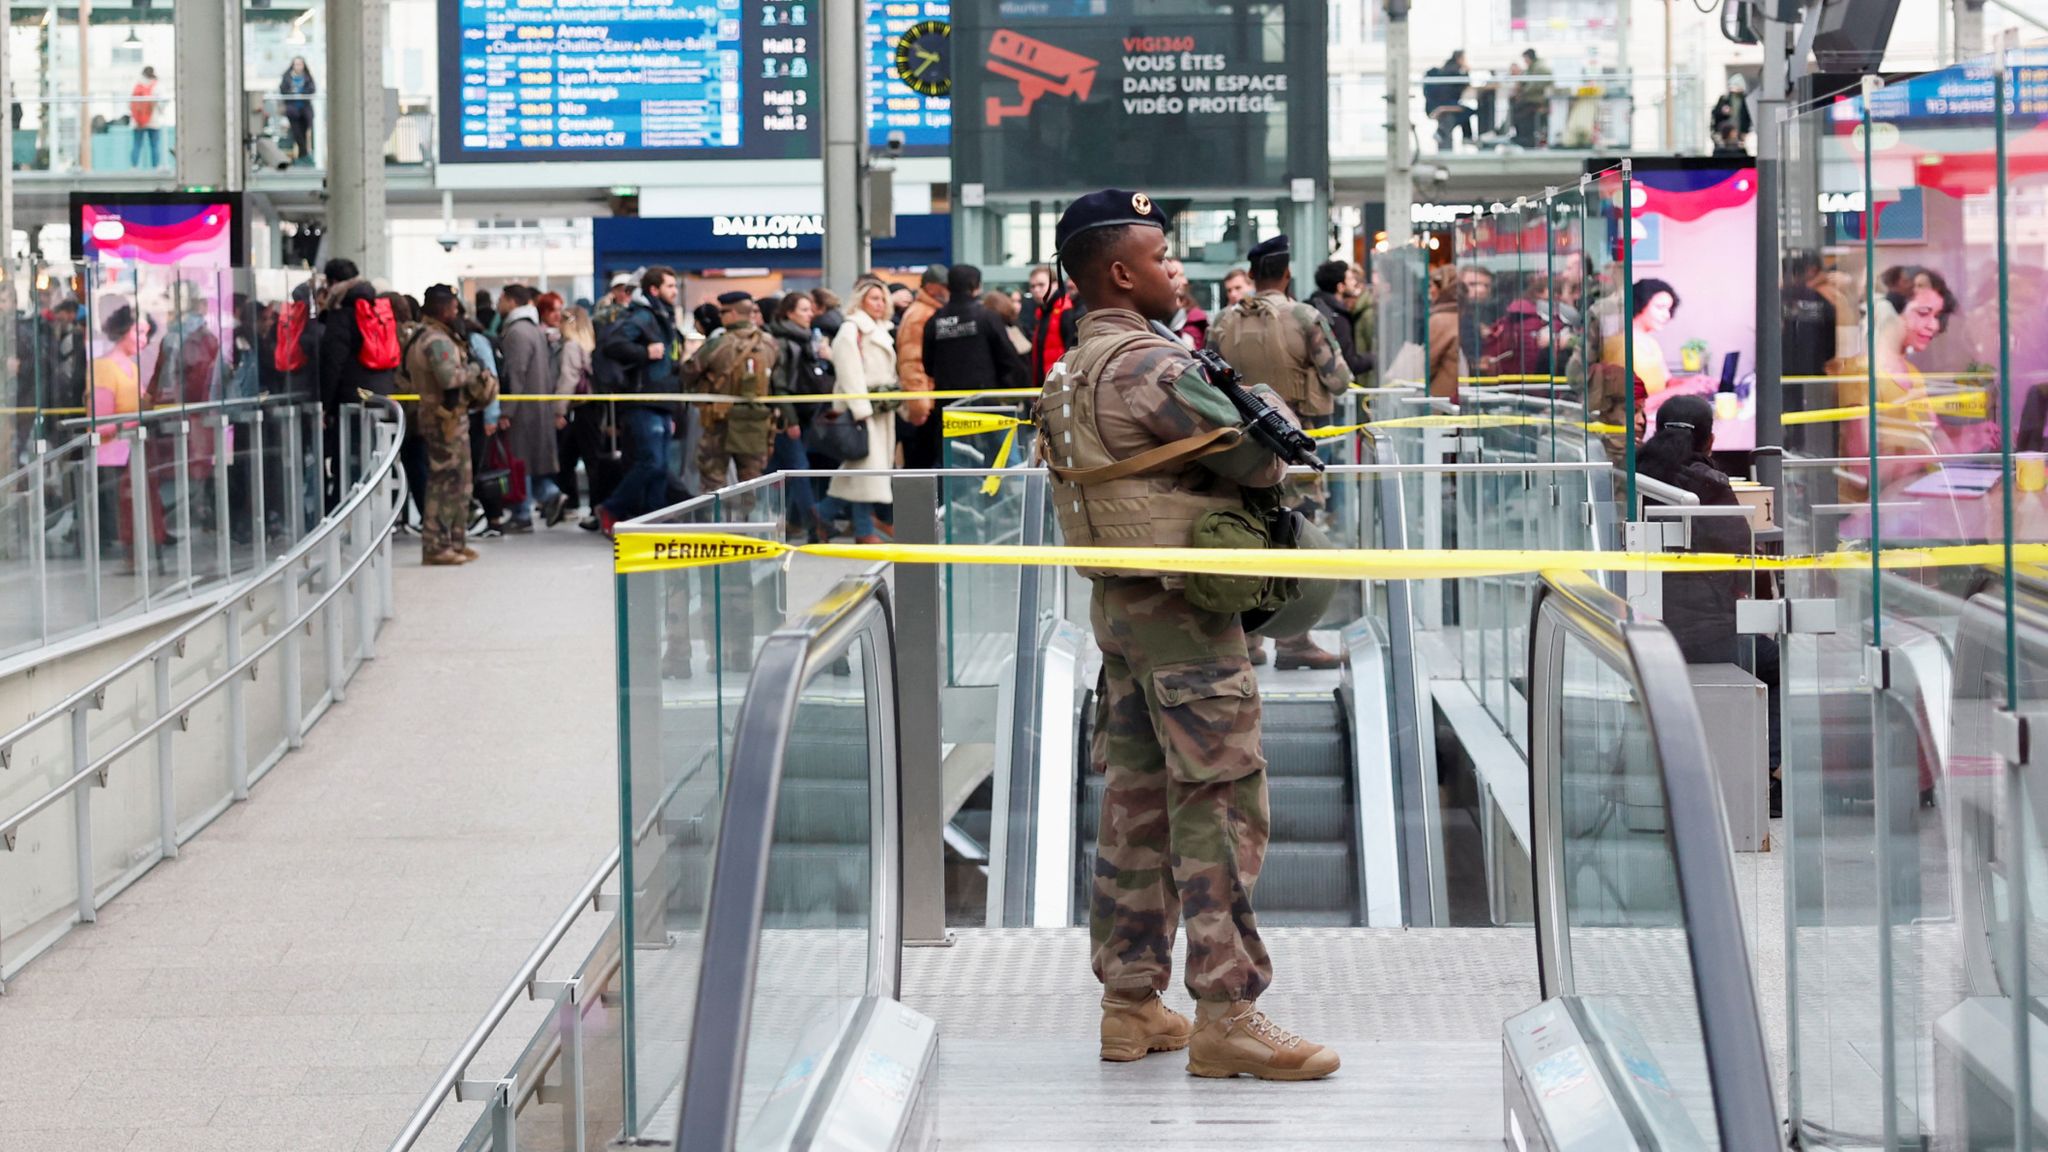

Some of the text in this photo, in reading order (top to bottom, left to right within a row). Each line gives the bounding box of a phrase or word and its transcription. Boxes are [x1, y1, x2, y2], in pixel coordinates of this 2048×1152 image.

[557, 24, 609, 40] Annecy
[763, 38, 806, 53] Hall 2
[1123, 37, 1195, 51] VIGI360
[1123, 52, 1226, 71] VOUS ÊTES
[558, 70, 588, 85] Lyon
[1123, 75, 1287, 93] DANS UN ESPACE
[763, 90, 807, 105] Hall 3
[1124, 95, 1183, 114] VIDÉO
[763, 115, 807, 130] Hall 2
[747, 236, 797, 249] PARIS
[654, 539, 768, 560] PÉRIMÈTRE
